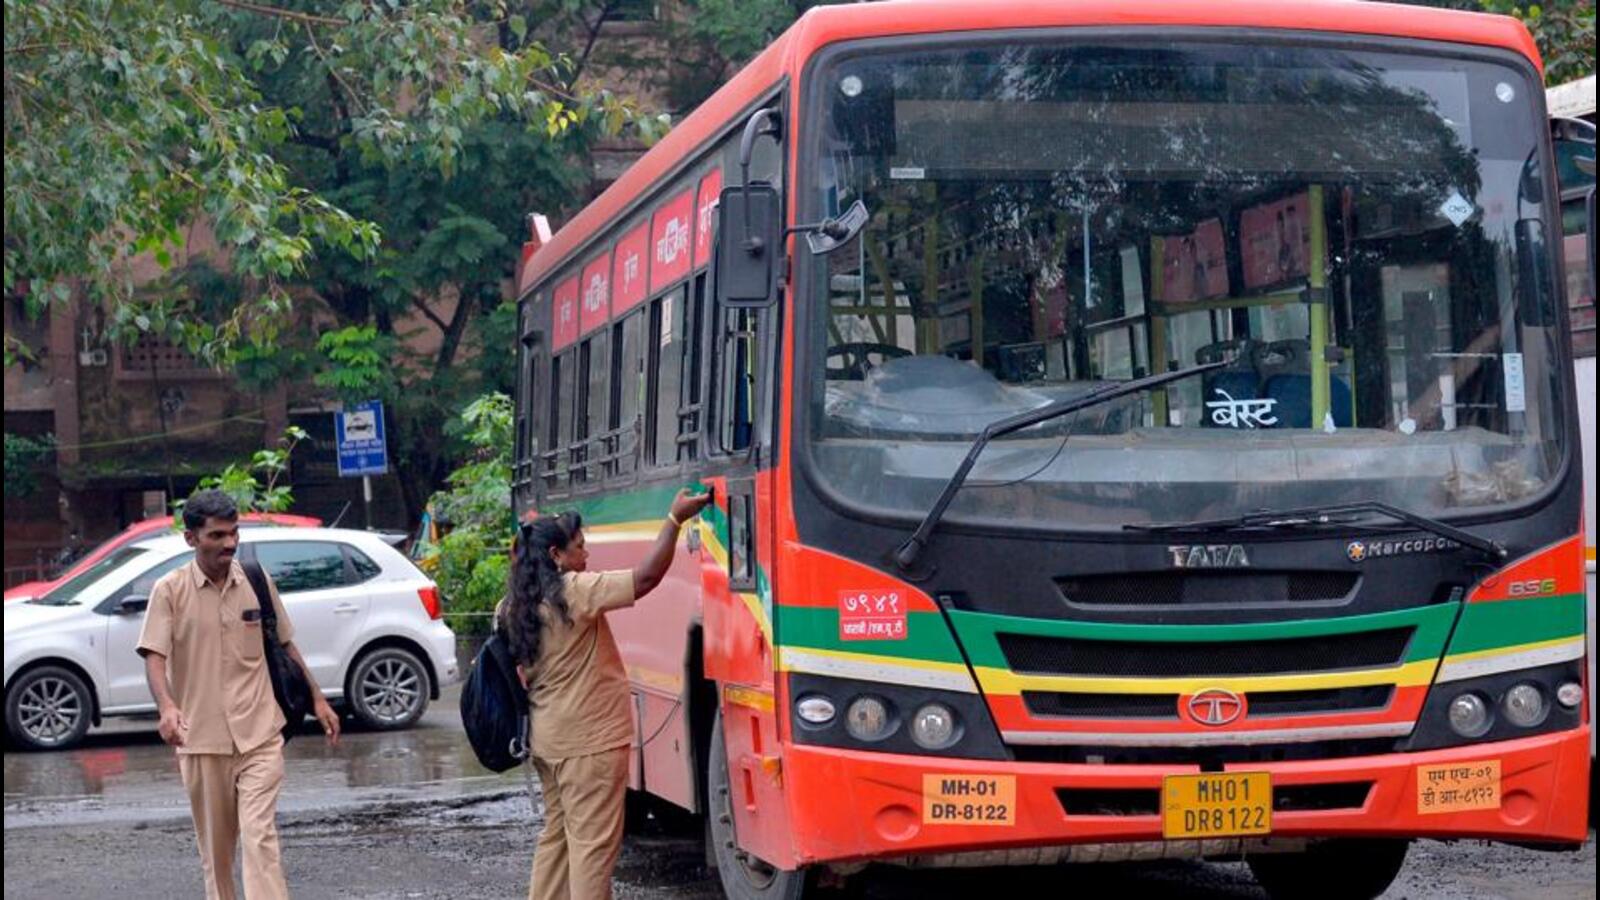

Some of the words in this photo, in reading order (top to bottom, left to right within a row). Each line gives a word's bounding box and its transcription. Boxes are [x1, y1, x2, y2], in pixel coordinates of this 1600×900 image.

[1206, 388, 1278, 427] बेस्ट
[1168, 544, 1249, 566] TATA
[1508, 579, 1556, 596] BS6
[844, 592, 899, 614] ७९४१
[1427, 769, 1446, 786] एम
[941, 780, 997, 796] MH-01
[1197, 778, 1249, 802] MH01
[1421, 787, 1436, 806] डी
[931, 803, 1007, 820] DR-8122
[1184, 806, 1265, 832] DR8122
